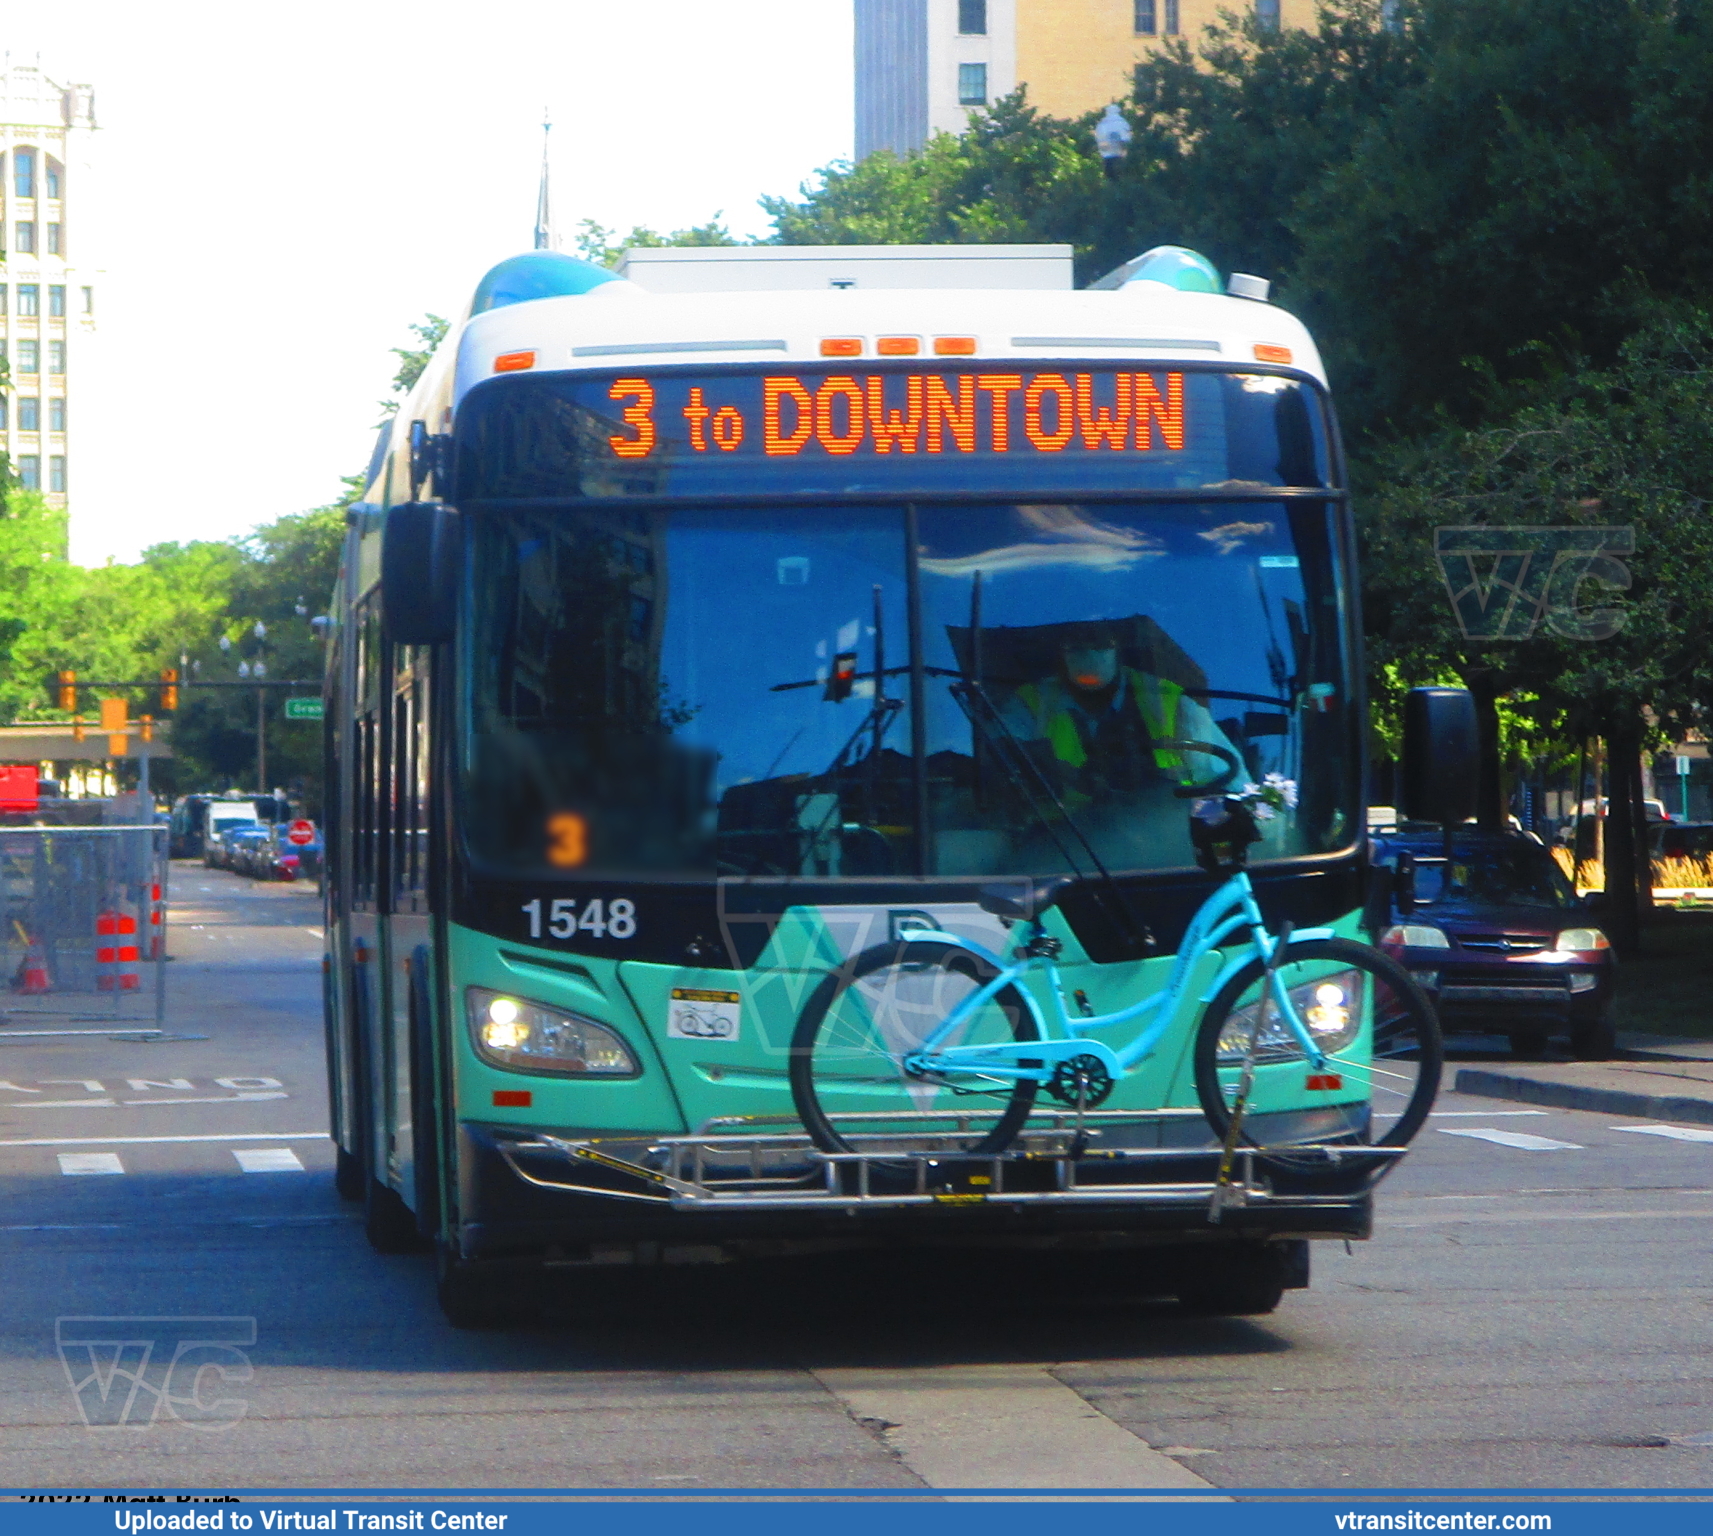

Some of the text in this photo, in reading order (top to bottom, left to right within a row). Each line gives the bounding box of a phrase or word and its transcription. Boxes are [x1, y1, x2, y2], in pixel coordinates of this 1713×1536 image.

[609, 372, 1184, 458] 3 to DOWNTOWN
[547, 812, 587, 867] 3
[521, 898, 637, 939] 1548
